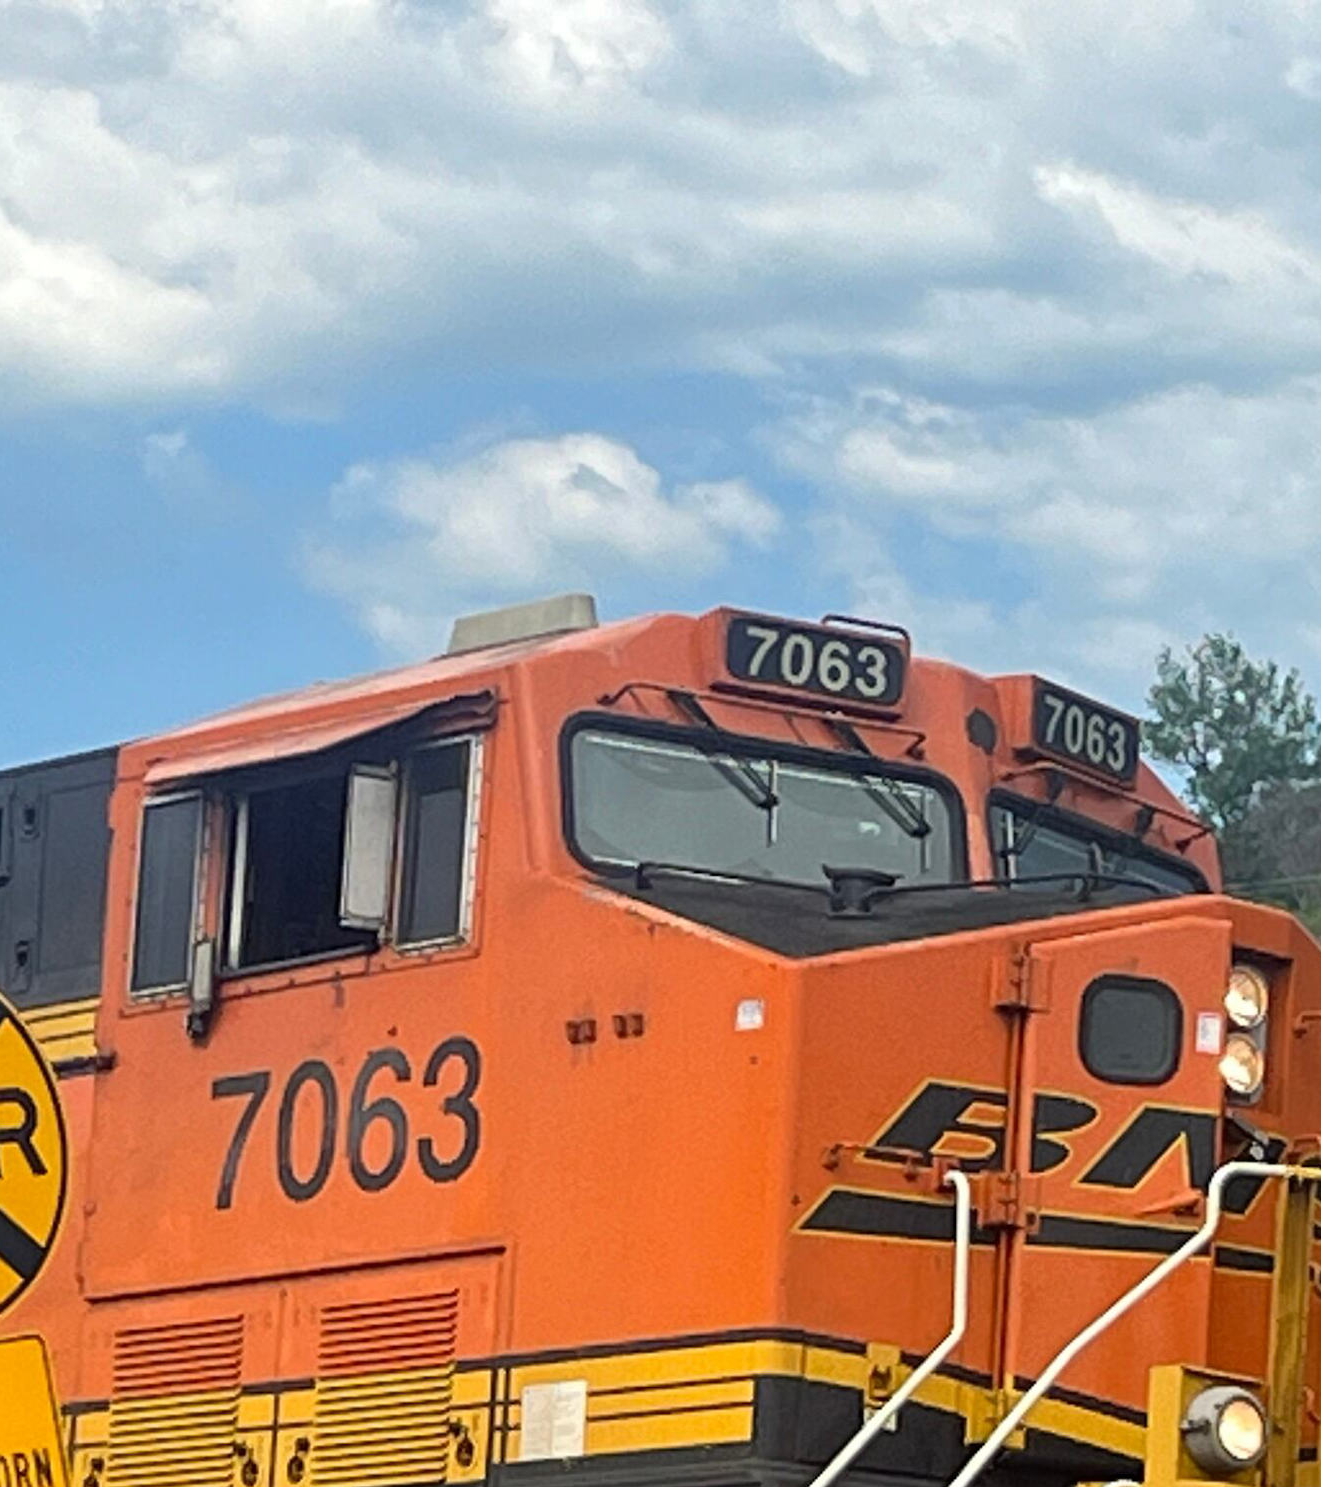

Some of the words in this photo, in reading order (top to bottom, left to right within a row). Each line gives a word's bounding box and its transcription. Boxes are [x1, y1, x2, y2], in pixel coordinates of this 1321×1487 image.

[745, 626, 889, 698] 7063
[1042, 693, 1127, 772] 7063
[211, 1036, 481, 1212] 7063
